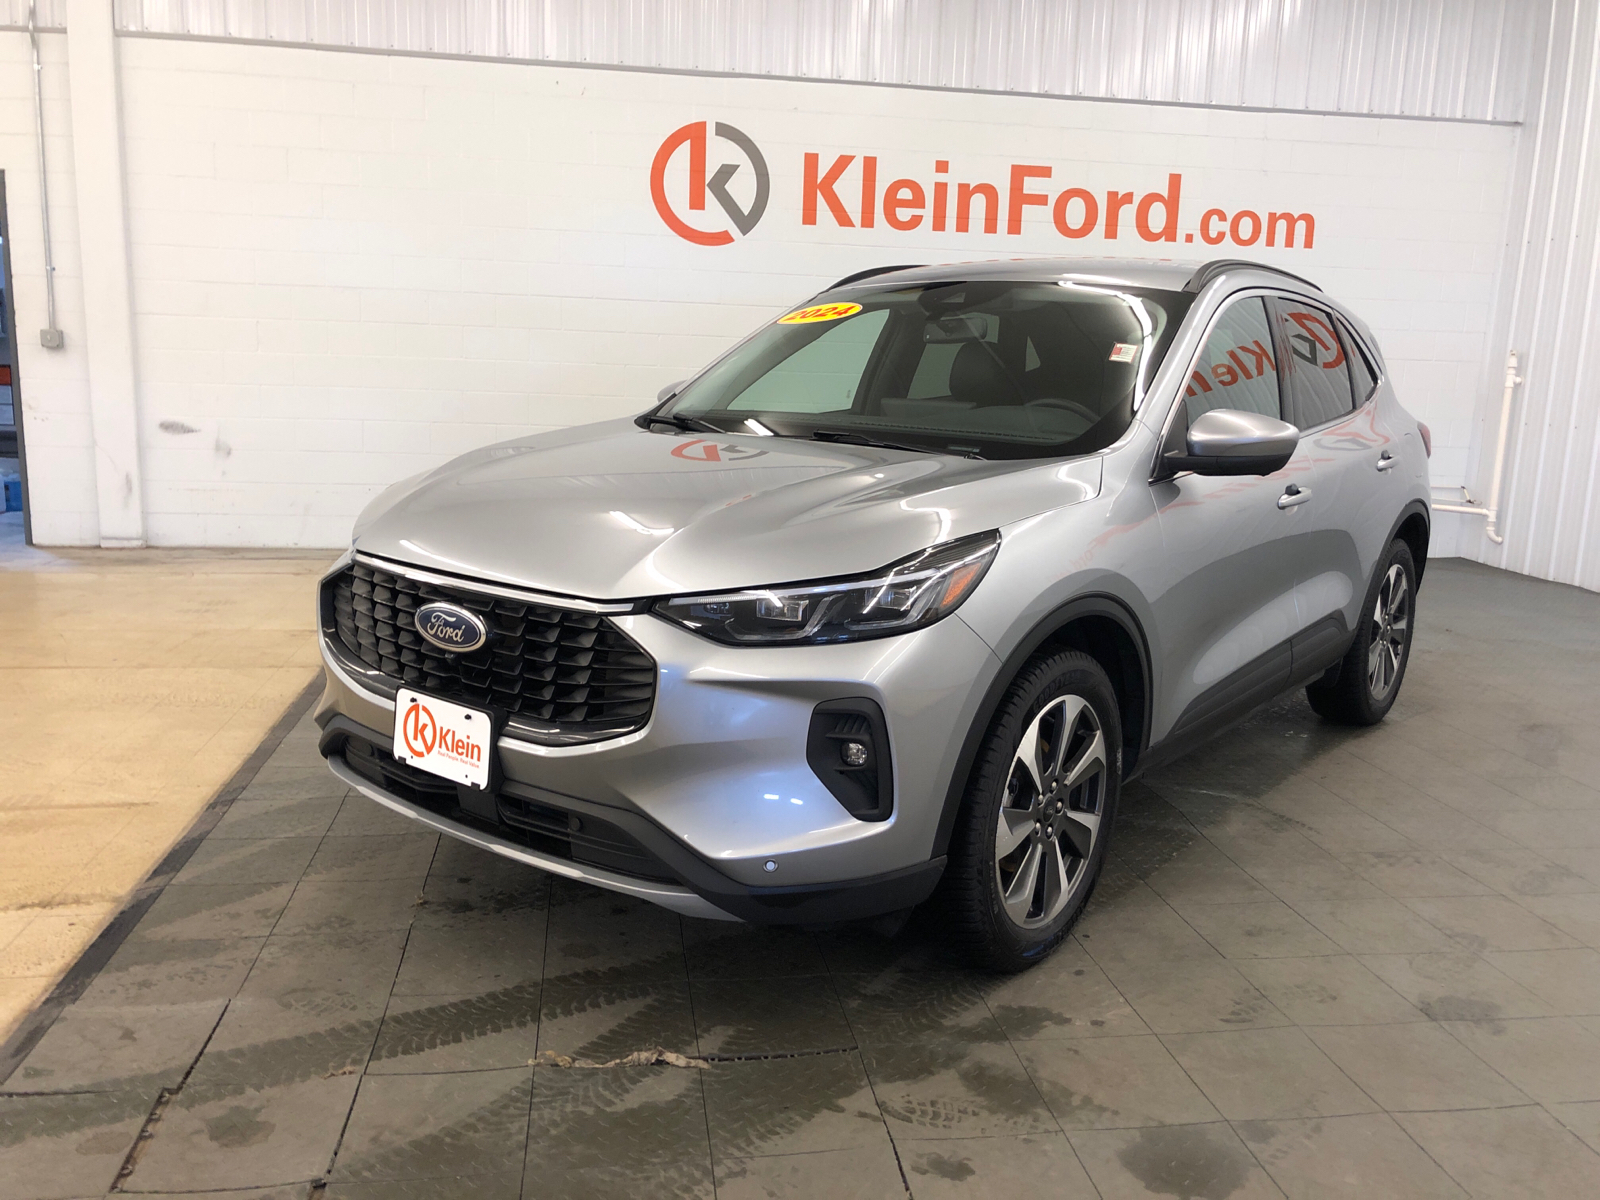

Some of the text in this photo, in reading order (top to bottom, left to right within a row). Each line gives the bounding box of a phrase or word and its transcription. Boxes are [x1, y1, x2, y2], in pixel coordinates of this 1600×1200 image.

[801, 152, 1316, 249] KleinFord.com
[782, 305, 856, 321] 2024
[427, 612, 466, 642] Ford
[439, 726, 481, 762] Klein
